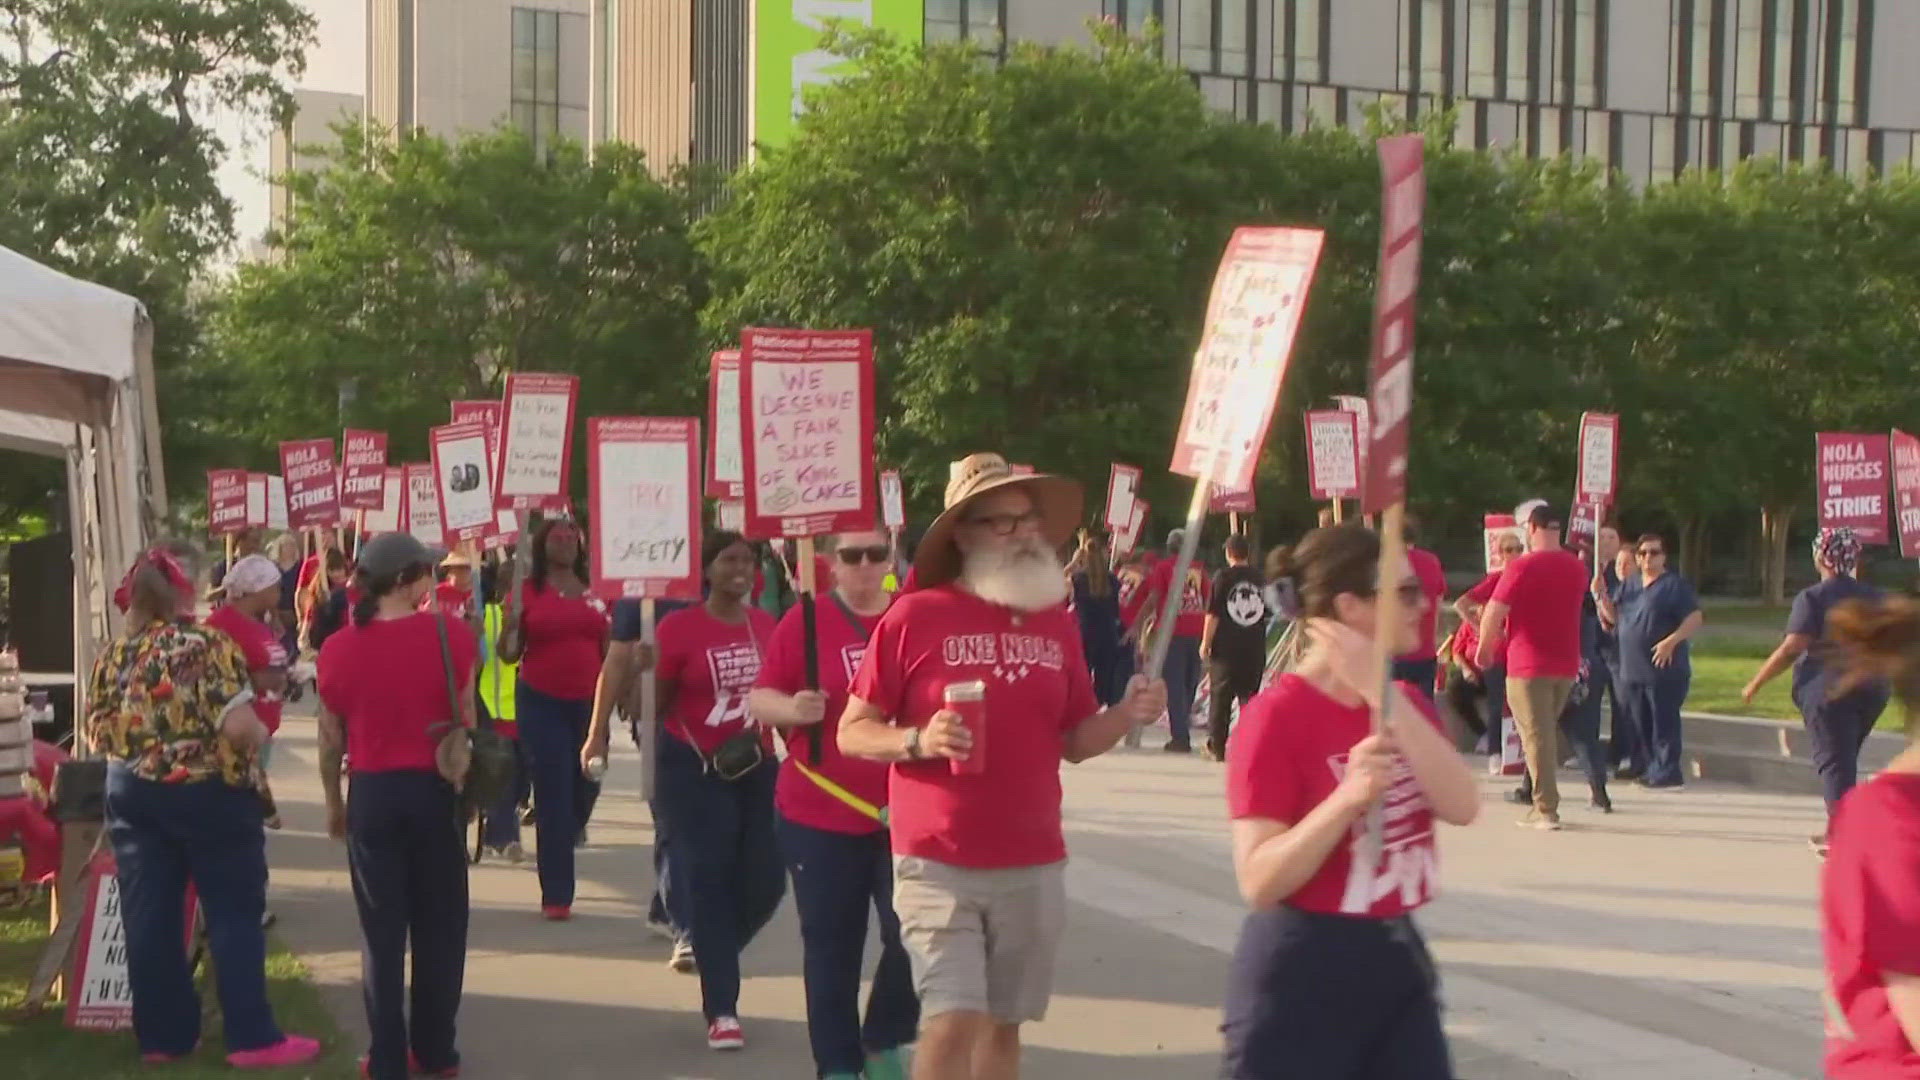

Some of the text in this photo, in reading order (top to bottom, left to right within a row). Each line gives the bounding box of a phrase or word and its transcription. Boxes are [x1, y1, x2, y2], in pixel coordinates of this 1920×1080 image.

[782, 368, 824, 390] WE
[761, 390, 855, 415] DESERVE
[761, 416, 843, 440] A FAIR
[348, 438, 374, 451] NOLA
[776, 440, 839, 462] SLICE
[1823, 442, 1865, 462] NOLA
[286, 448, 318, 466] NOLA
[346, 450, 385, 467] NURSES
[212, 476, 236, 489] NOLA
[287, 459, 332, 484] NURSES
[759, 468, 785, 487] OF
[1823, 461, 1883, 483] NURSES
[344, 474, 383, 494] STRIKE
[802, 480, 859, 503] CAKE
[1828, 484, 1843, 497] ON
[290, 485, 335, 511] STRIKE
[1823, 496, 1882, 519] STRIKE
[213, 504, 245, 523] STRIKE
[943, 633, 997, 667] ONE
